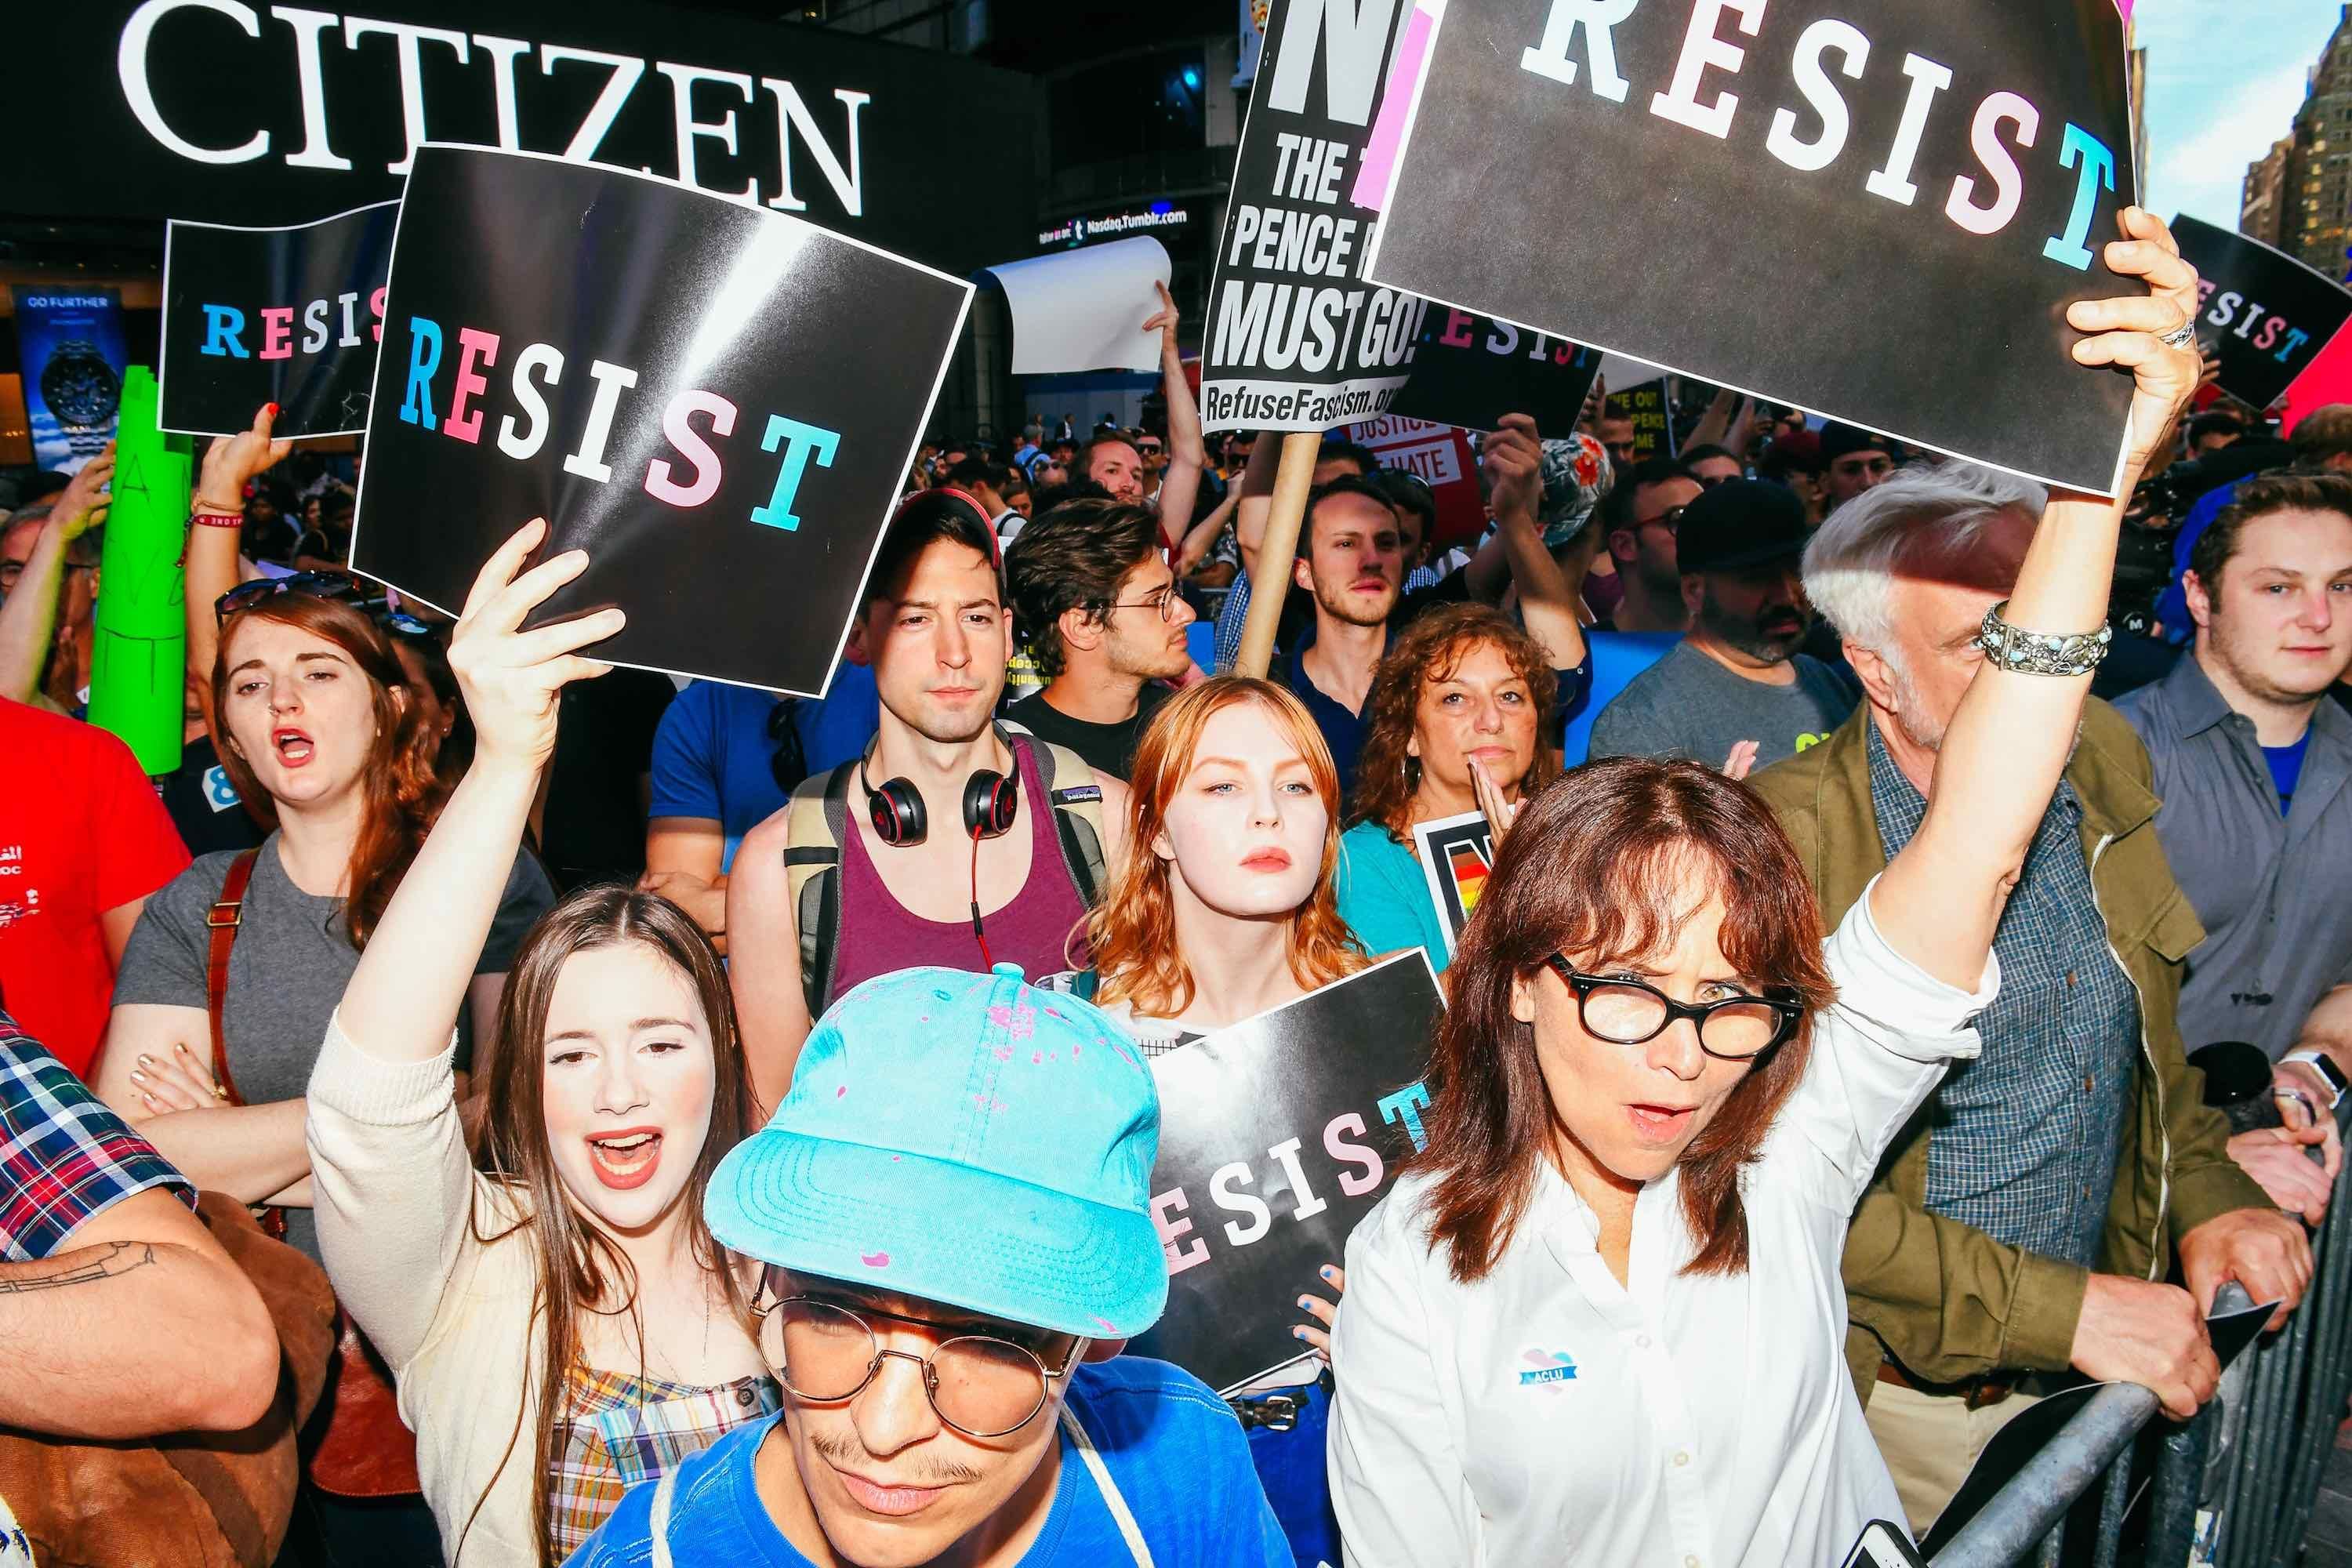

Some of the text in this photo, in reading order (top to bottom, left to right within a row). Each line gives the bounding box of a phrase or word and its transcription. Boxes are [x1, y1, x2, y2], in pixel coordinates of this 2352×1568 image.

[1268, 0, 1416, 127] N
[118, 0, 870, 217] CITIZEN
[1520, 0, 2115, 271] RESIST
[1272, 132, 1349, 205] THE
[1229, 205, 1357, 278] PENCE
[28, 296, 108, 308] GO FURTHER
[1211, 280, 1428, 373] MUST GO!
[400, 316, 841, 532] RESIST
[1207, 386, 1396, 422] RefuseFascism.or
[2129, 619, 2143, 630] M
[1535, 1369, 1564, 1383] ACLU
